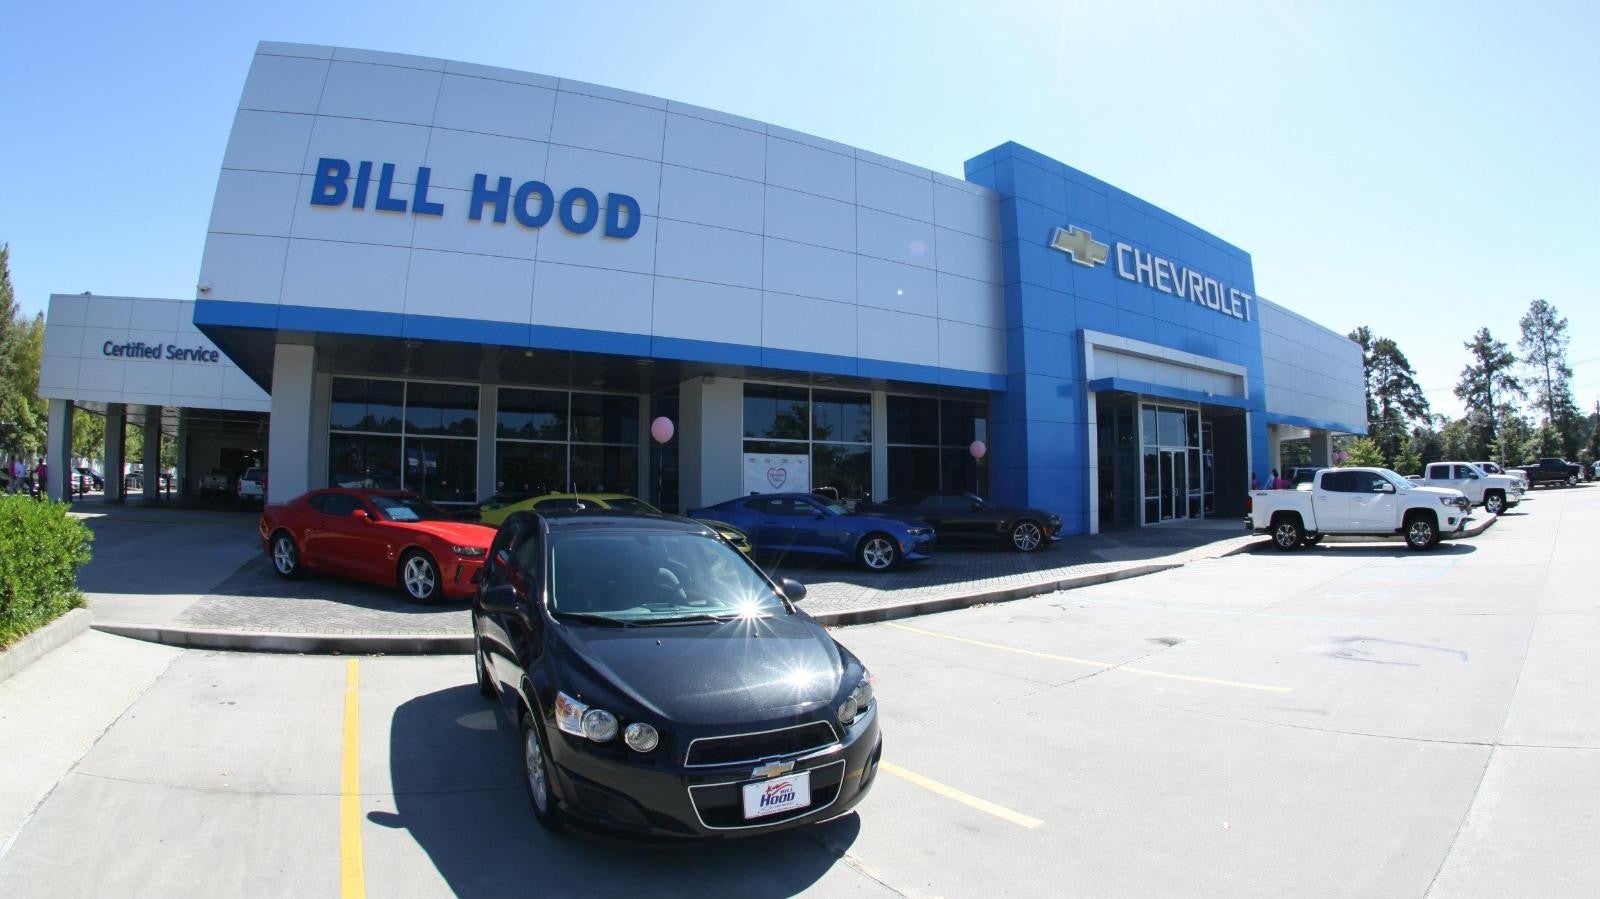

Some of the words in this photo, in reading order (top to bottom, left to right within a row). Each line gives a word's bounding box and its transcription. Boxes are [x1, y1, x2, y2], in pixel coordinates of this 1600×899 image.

[310, 157, 444, 216] BILL
[468, 173, 641, 239] HOOD
[1116, 242, 1252, 321] CHEVROLET
[103, 341, 162, 359] Certified
[166, 344, 219, 362] Service
[760, 792, 795, 807] HOOD
